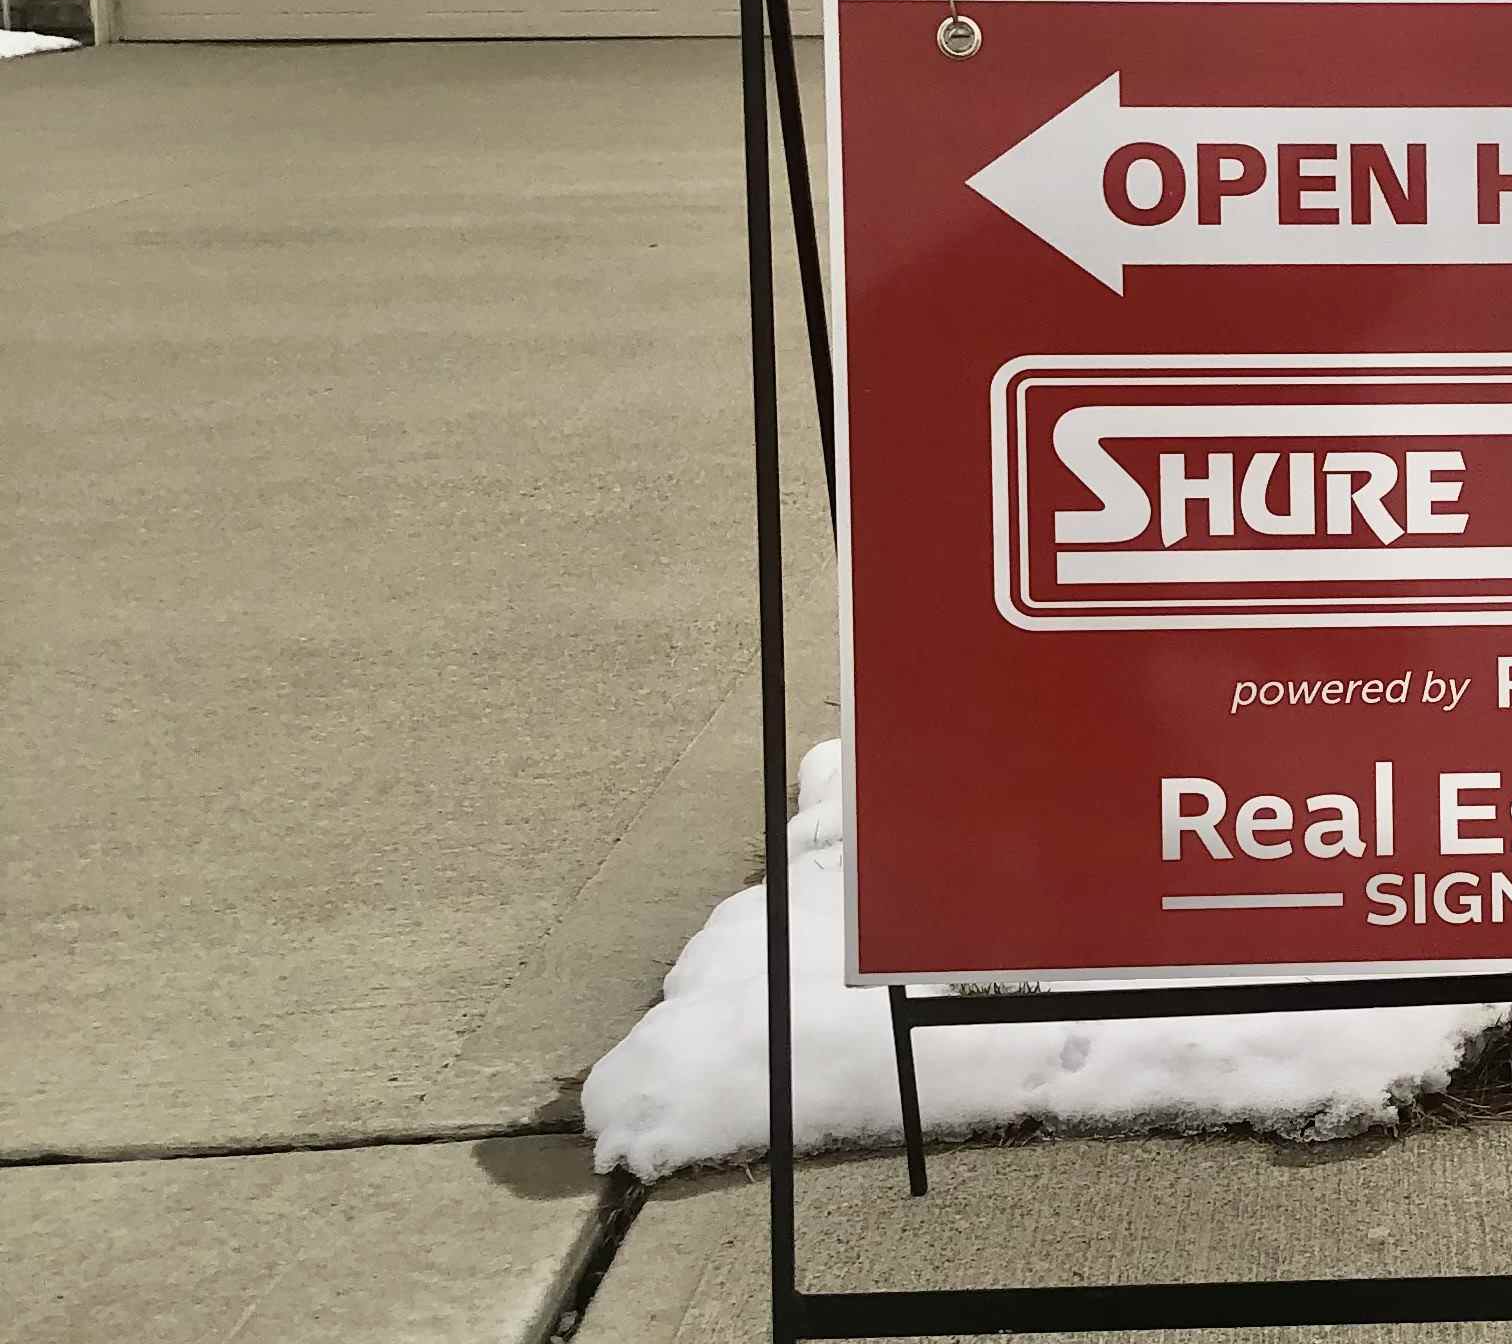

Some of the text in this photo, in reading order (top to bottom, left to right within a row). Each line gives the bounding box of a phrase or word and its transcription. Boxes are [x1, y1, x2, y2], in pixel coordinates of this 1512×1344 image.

[1101, 142, 1428, 226] OPEN
[1052, 403, 1469, 548] SHURE
[1230, 673, 1413, 714] powered
[1421, 668, 1470, 712] by
[1159, 761, 1395, 862] Real
